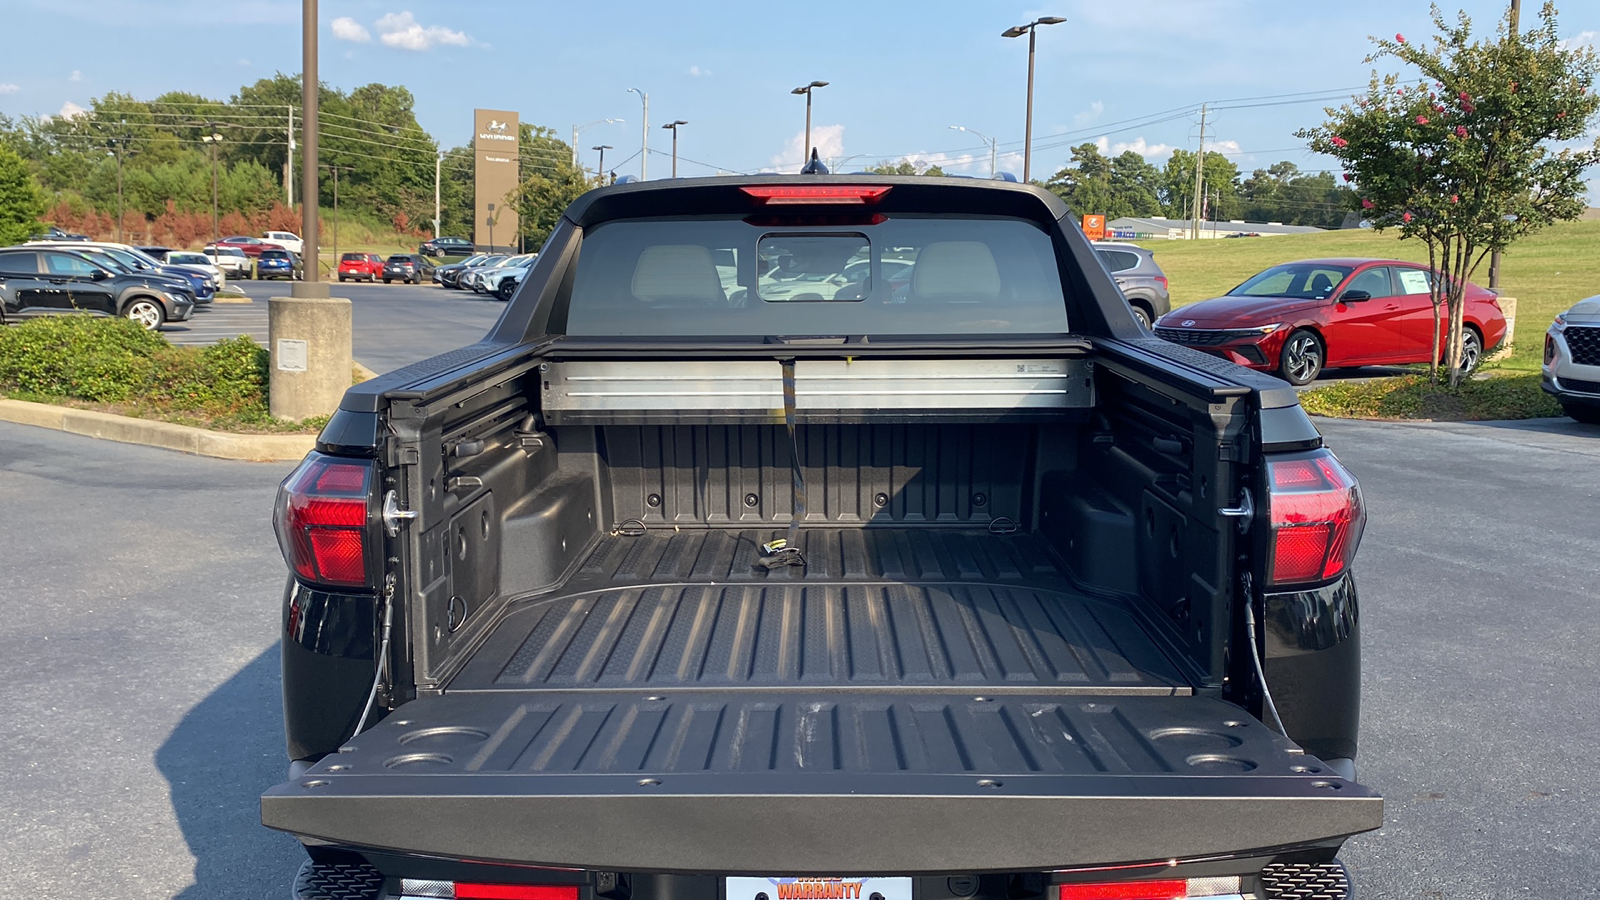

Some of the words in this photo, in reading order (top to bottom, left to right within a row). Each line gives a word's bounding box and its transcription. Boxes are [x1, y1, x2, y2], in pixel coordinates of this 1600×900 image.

[480, 133, 515, 141] HYUNDAI
[1113, 231, 1136, 239] TOBACCO
[777, 882, 863, 900] WARRANTY
